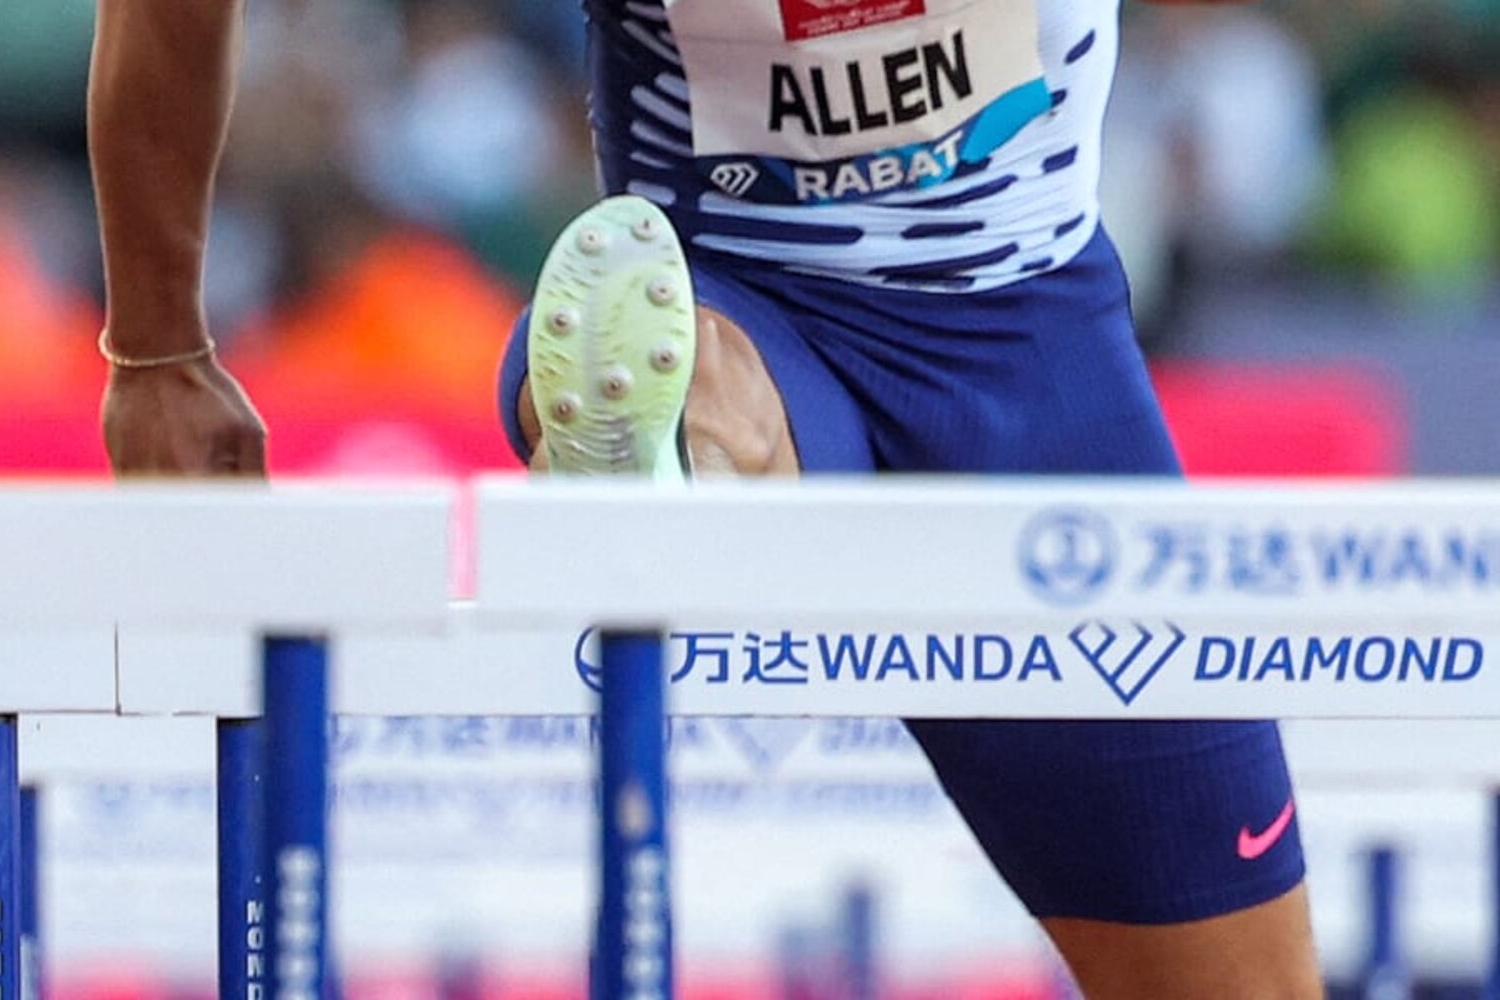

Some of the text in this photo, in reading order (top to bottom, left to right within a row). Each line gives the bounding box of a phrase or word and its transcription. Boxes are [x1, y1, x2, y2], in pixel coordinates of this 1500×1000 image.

[768, 29, 973, 137] ALLEN
[794, 130, 964, 200] RABAT
[668, 631, 1484, 683] 万达 WANDA DIAMOND
